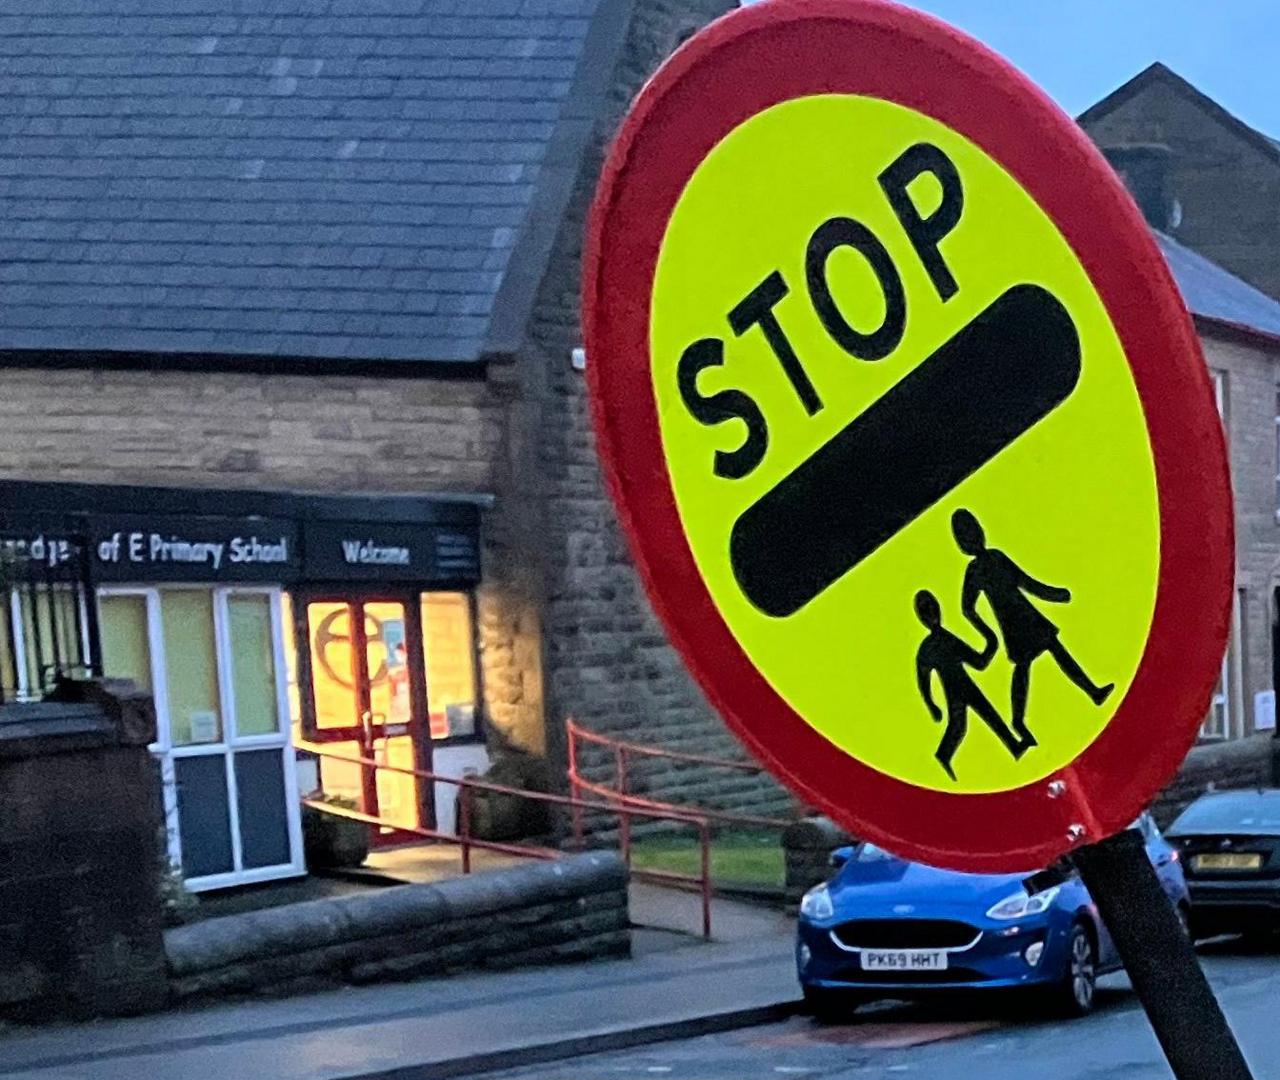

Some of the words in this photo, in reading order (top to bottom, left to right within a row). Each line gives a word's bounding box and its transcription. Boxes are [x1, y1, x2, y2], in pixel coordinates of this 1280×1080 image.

[676, 142, 964, 480] STOP
[98, 532, 121, 562] of
[129, 532, 143, 561] E
[150, 533, 223, 570] Primary
[229, 536, 287, 562] School
[342, 538, 410, 565] Welcome
